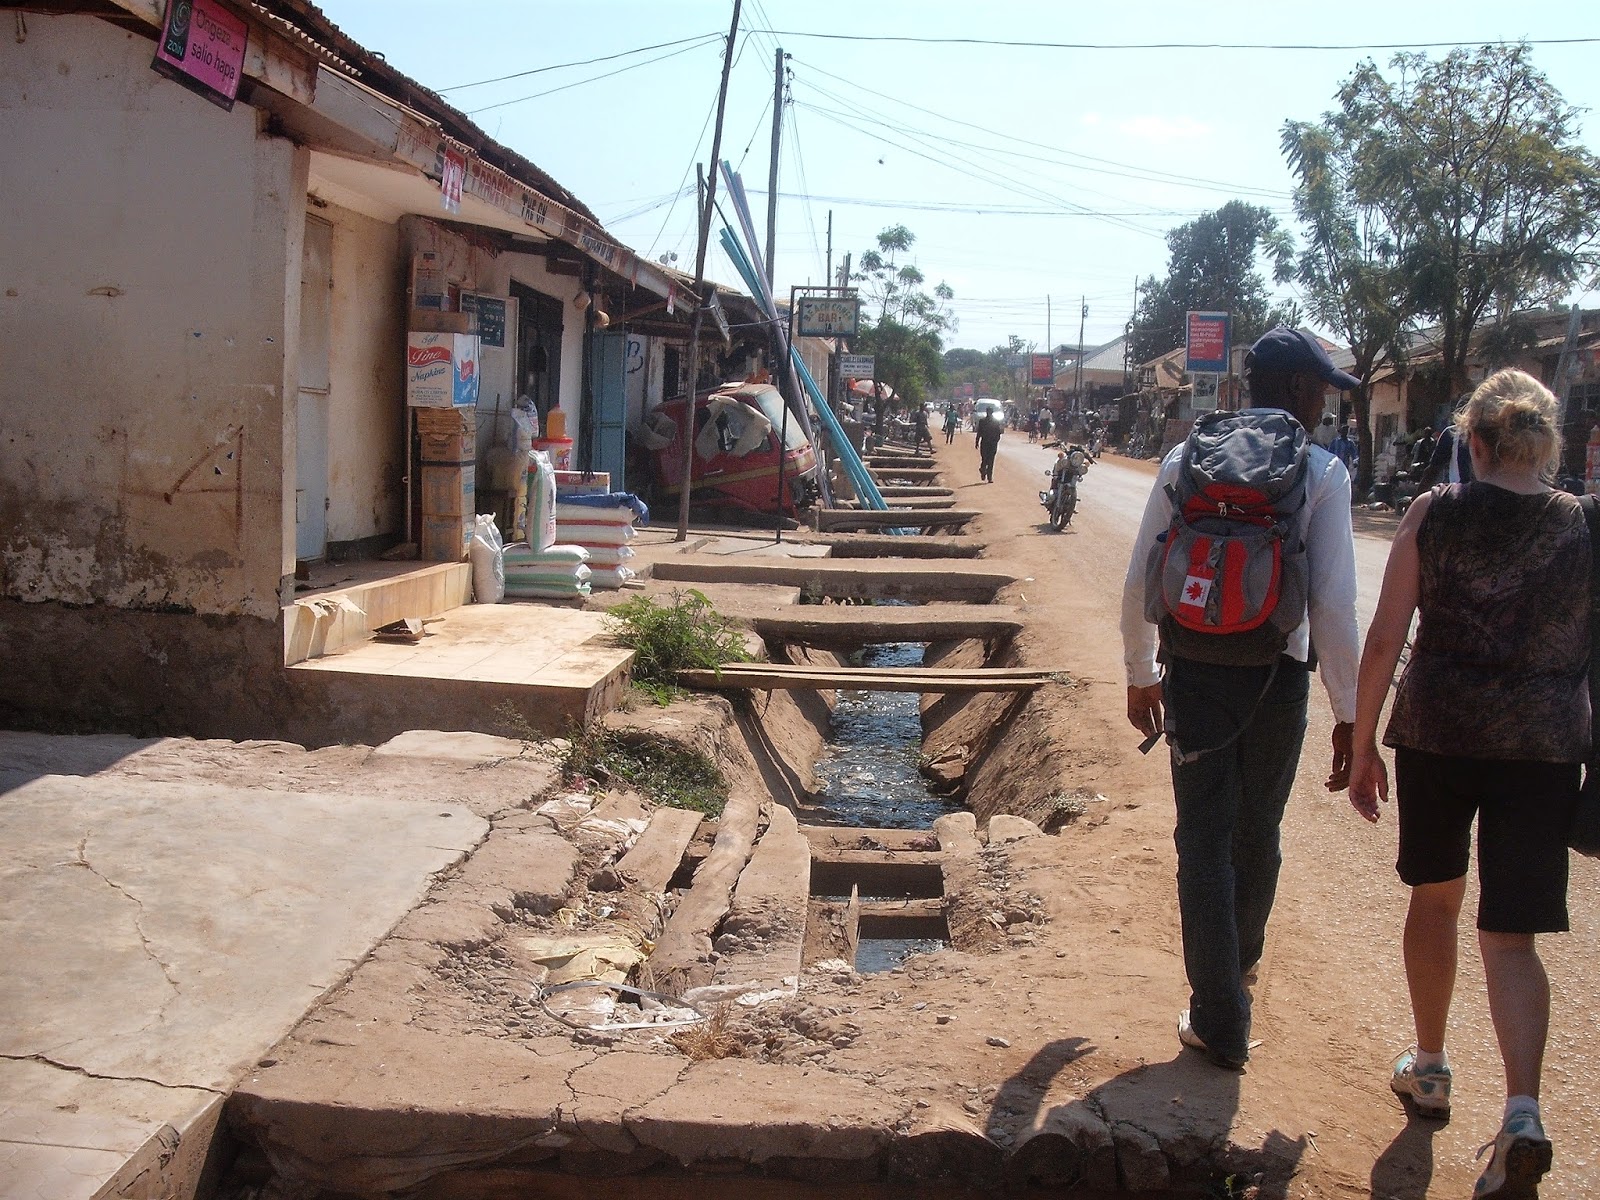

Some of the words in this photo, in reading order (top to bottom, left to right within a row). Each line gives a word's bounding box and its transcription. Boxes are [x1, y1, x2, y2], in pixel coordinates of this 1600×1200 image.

[191, 42, 213, 66] salio
[214, 51, 236, 82] hapa
[818, 312, 837, 323] BAR
[411, 367, 446, 382] Napkins
